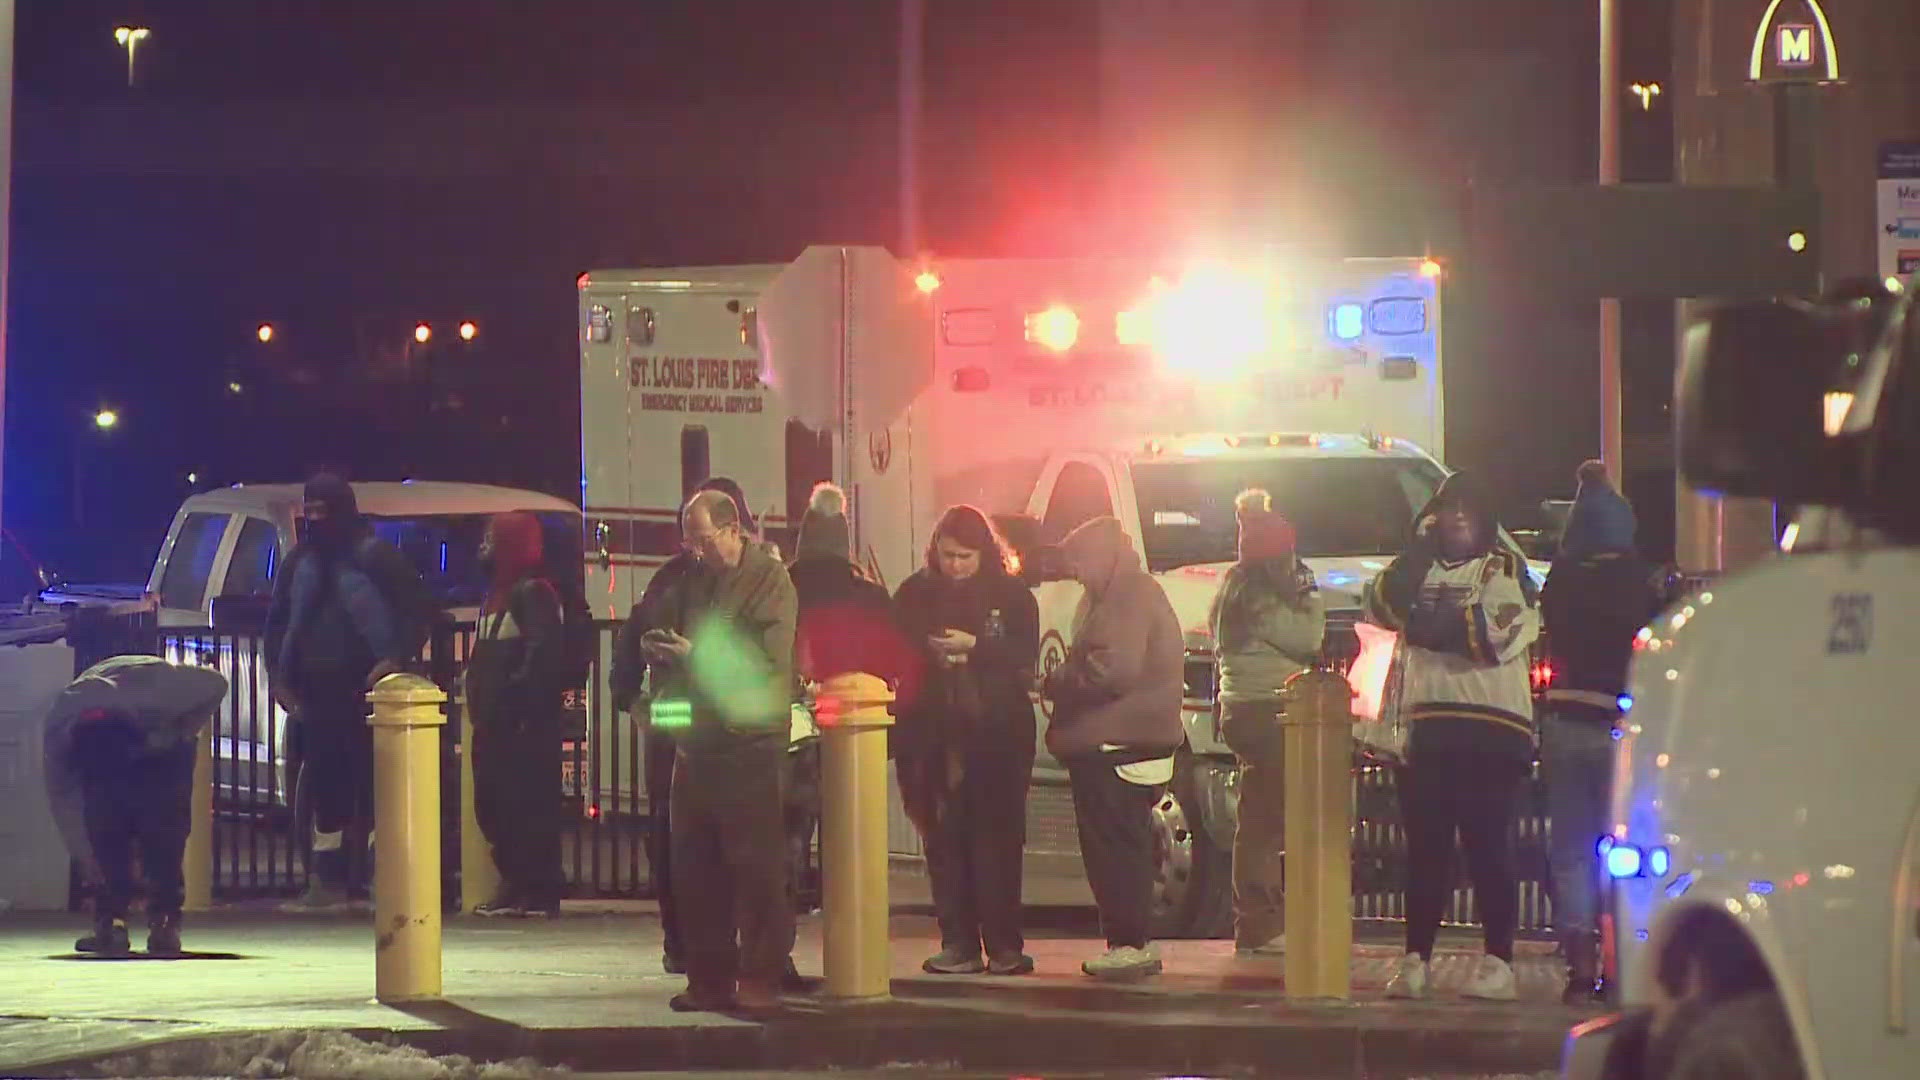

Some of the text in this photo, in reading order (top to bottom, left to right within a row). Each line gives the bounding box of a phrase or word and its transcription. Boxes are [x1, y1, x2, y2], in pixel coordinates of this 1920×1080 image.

[1780, 28, 1811, 62] M
[631, 358, 651, 387] ST.
[654, 357, 694, 389] LOUIS
[697, 359, 729, 389] FIRE
[641, 393, 763, 413] EMERGENCY MEDICAL SERVICES
